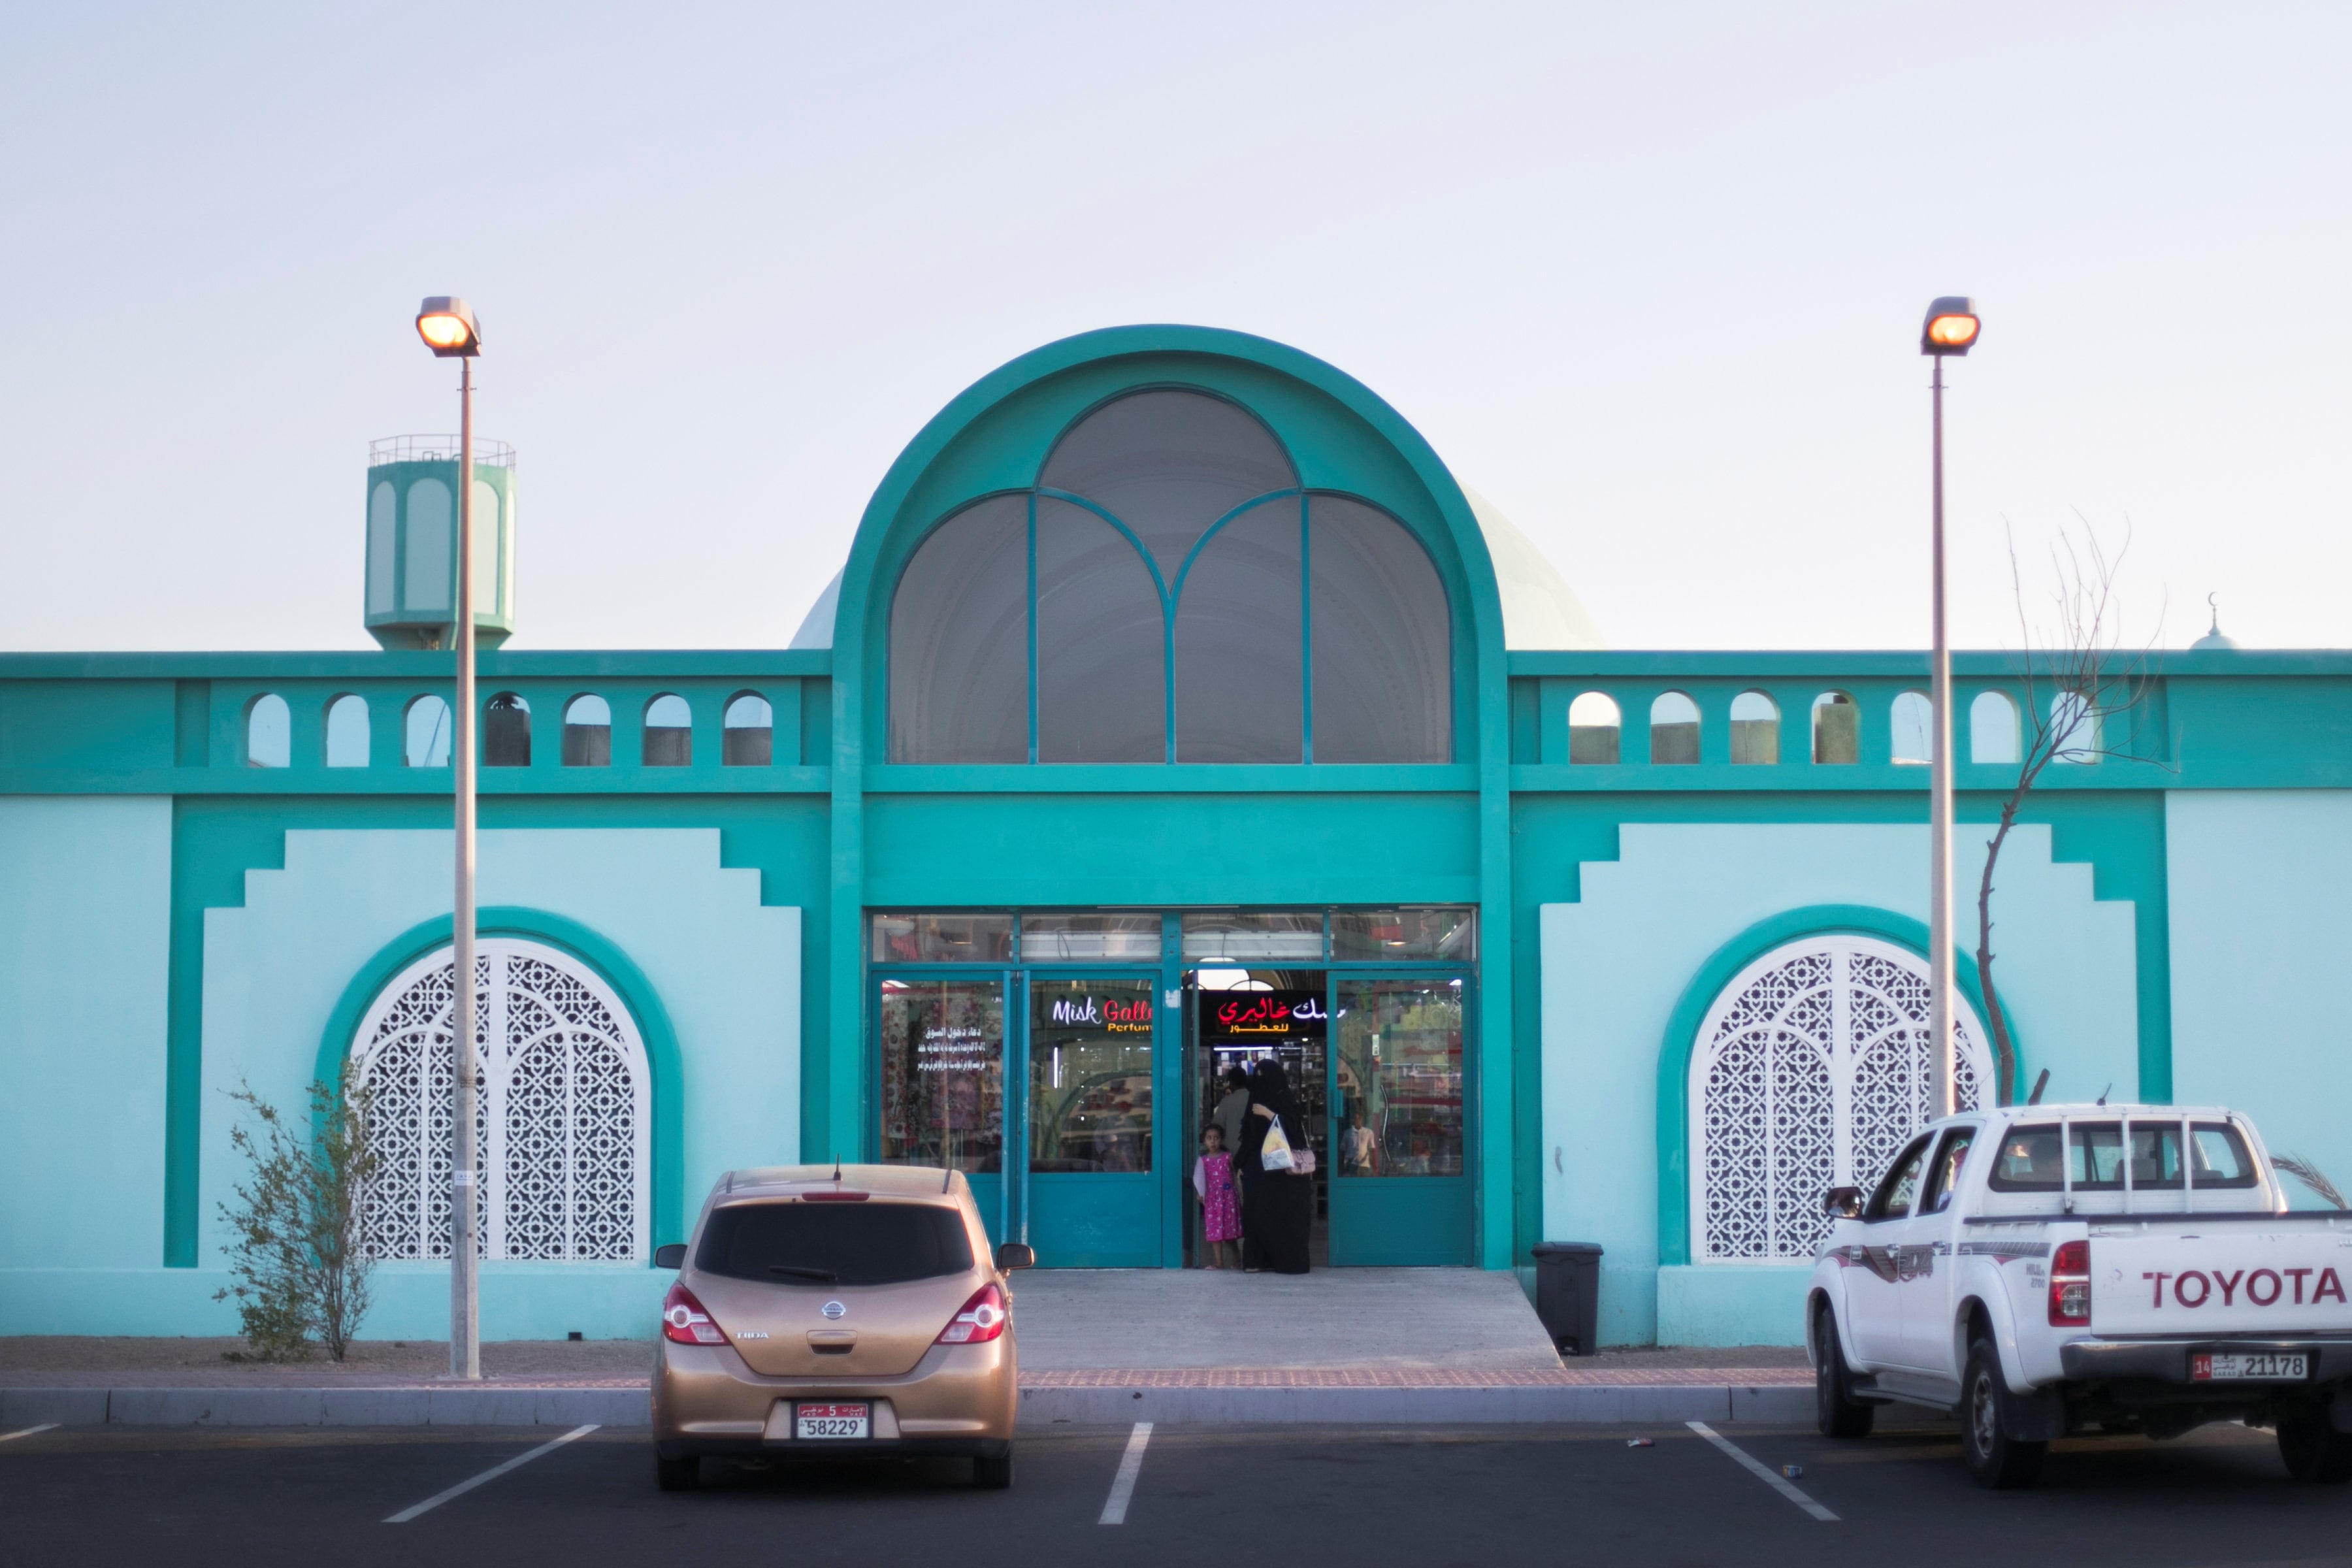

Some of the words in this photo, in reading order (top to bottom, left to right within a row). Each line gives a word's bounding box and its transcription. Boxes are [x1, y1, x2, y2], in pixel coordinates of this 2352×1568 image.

[1053, 996, 1102, 1024] Misk
[1217, 997, 1290, 1025] غاليري
[1230, 1023, 1289, 1034] للعطور
[2143, 1267, 2347, 1308] TOYOTA
[2196, 1360, 2210, 1374] 14
[2245, 1357, 2304, 1376] 21178
[829, 1405, 837, 1416] 5
[807, 1420, 858, 1435] 58229
